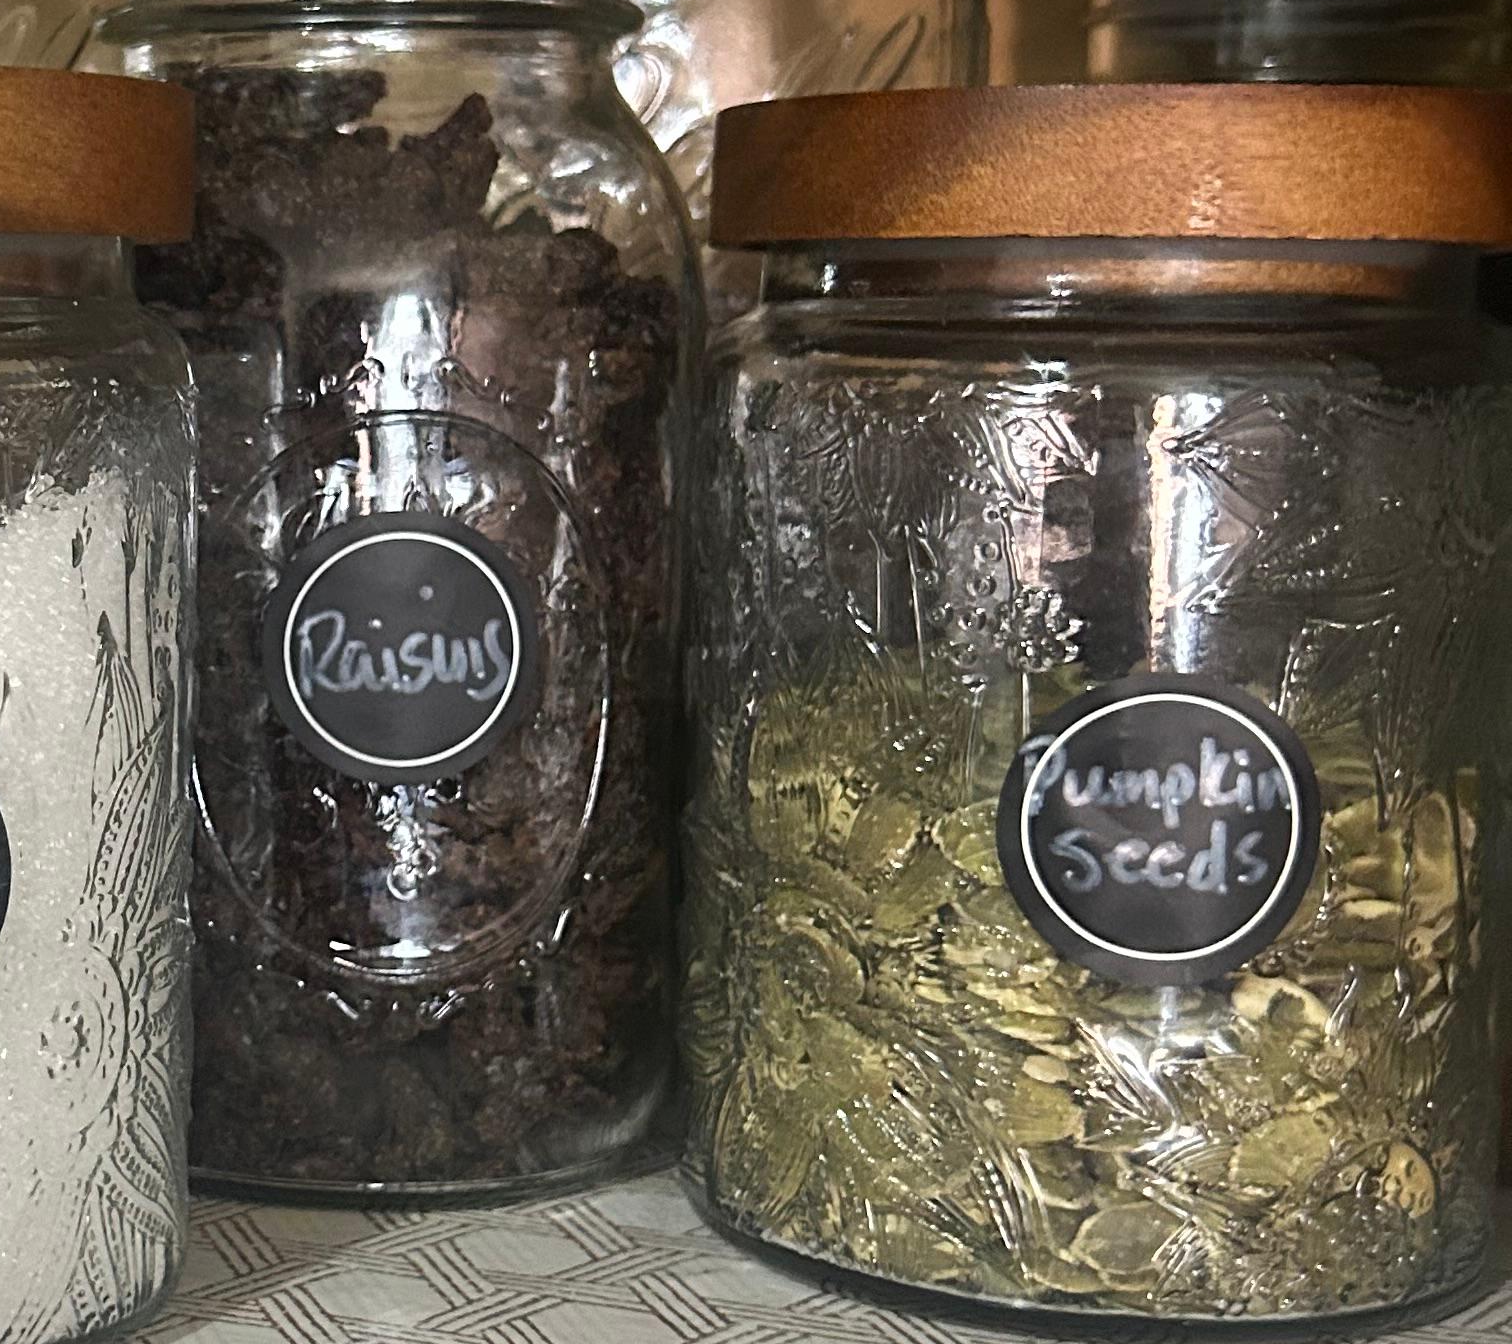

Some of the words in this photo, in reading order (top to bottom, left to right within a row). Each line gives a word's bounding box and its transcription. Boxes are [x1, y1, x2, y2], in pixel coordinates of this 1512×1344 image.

[297, 585, 509, 701] Raisins
[1018, 734, 1292, 829] Pumpkin
[1048, 819, 1269, 894] Seeds
